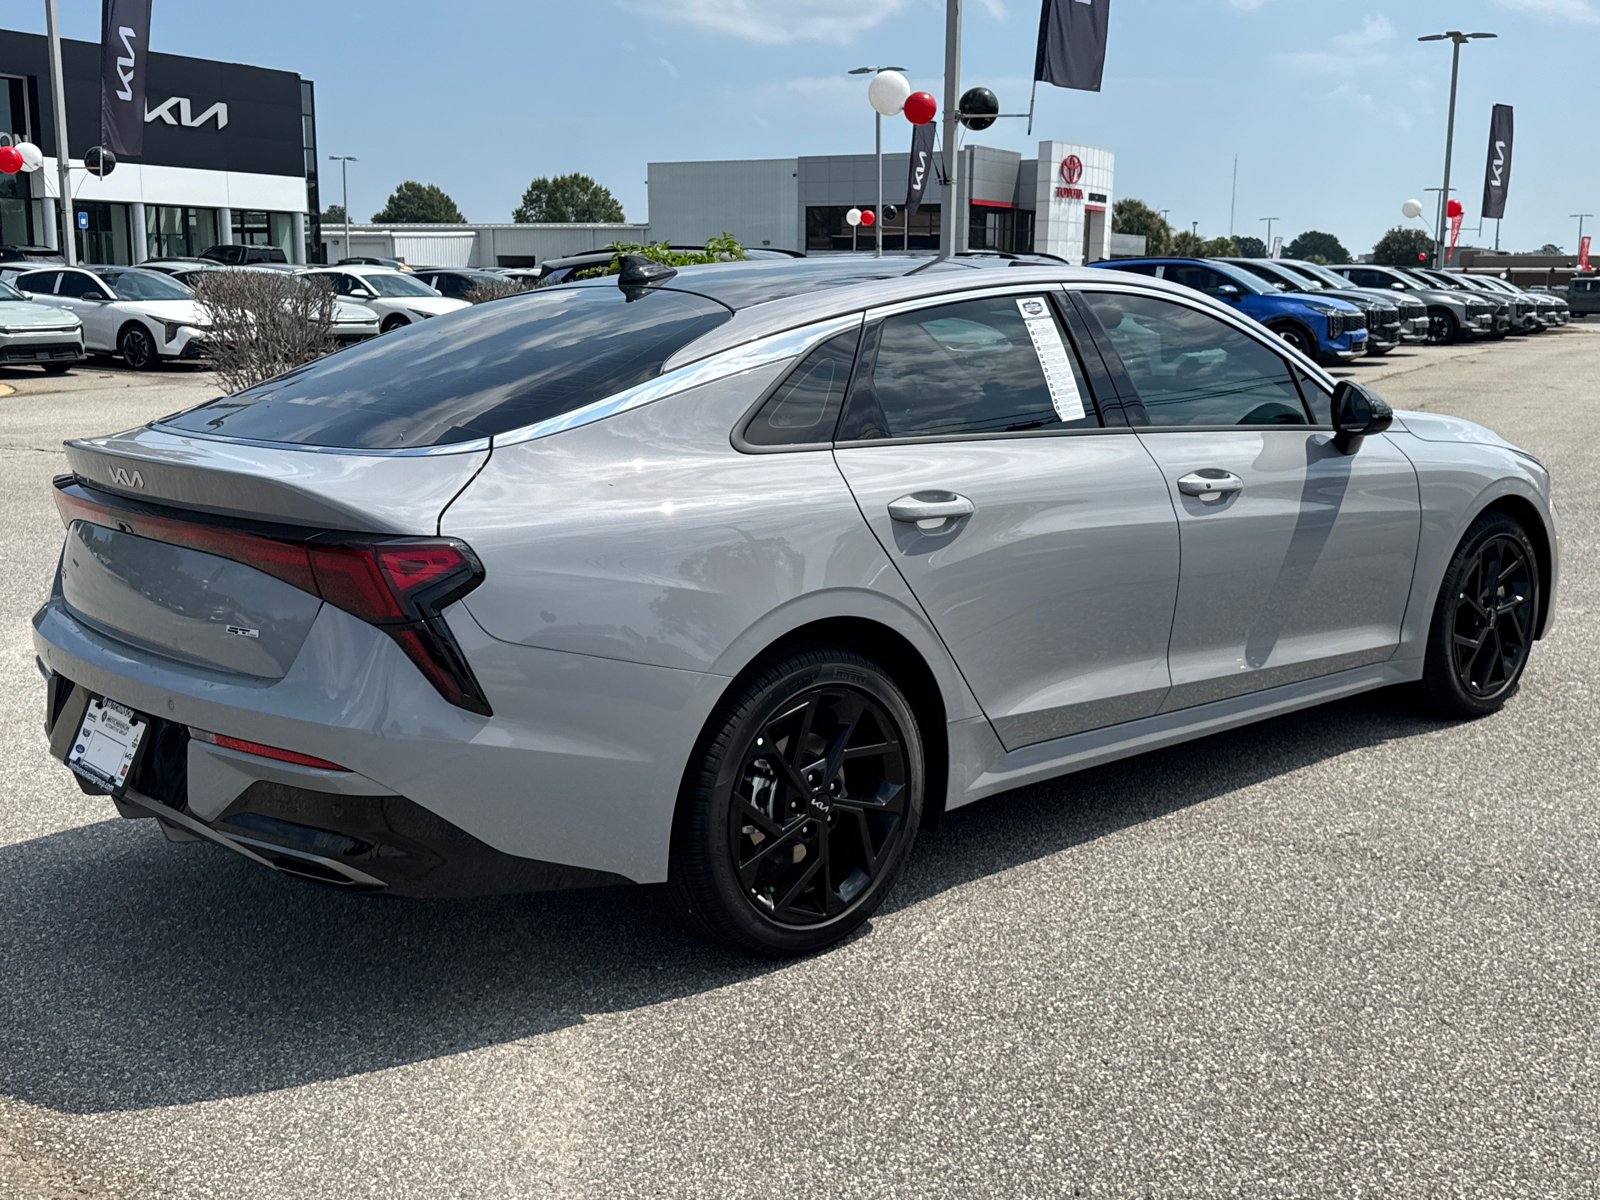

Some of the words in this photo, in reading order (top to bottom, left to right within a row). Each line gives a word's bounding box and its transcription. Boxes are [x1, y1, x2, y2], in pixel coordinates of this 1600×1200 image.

[116, 26, 136, 101] KIA
[144, 96, 228, 130] KIA
[913, 151, 927, 190] KIA
[1491, 140, 1506, 187] KIA
[1056, 187, 1084, 200] TOYOTA
[108, 465, 145, 489] KIA
[832, 666, 868, 685] PIRELLI
[811, 798, 830, 812] KIA
